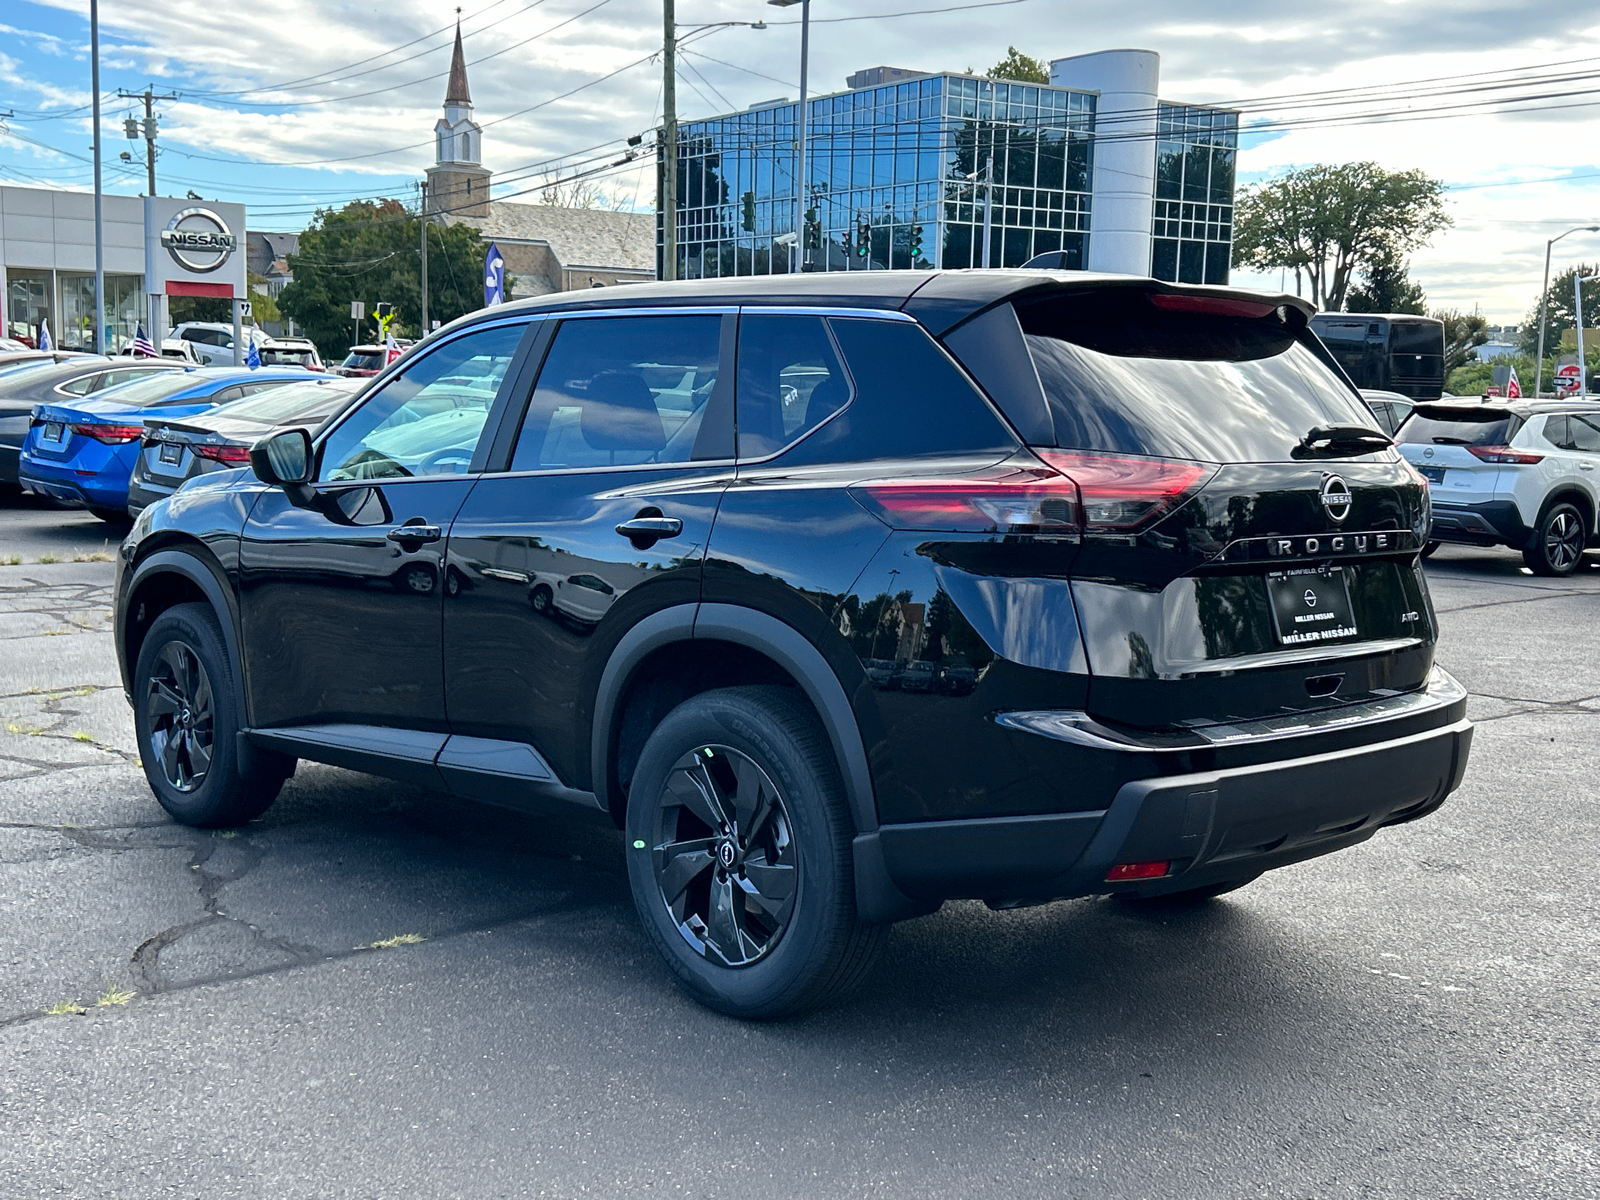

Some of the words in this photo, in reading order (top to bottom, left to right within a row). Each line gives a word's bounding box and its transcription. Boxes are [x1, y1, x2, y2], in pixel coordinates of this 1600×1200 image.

[170, 234, 230, 247] NISSAN
[1277, 533, 1388, 556] ROGUE
[1294, 614, 1314, 623] MILLER
[1314, 612, 1335, 621] NISSAN
[1282, 631, 1321, 645] MILLER
[1321, 626, 1358, 639] NISSAN
